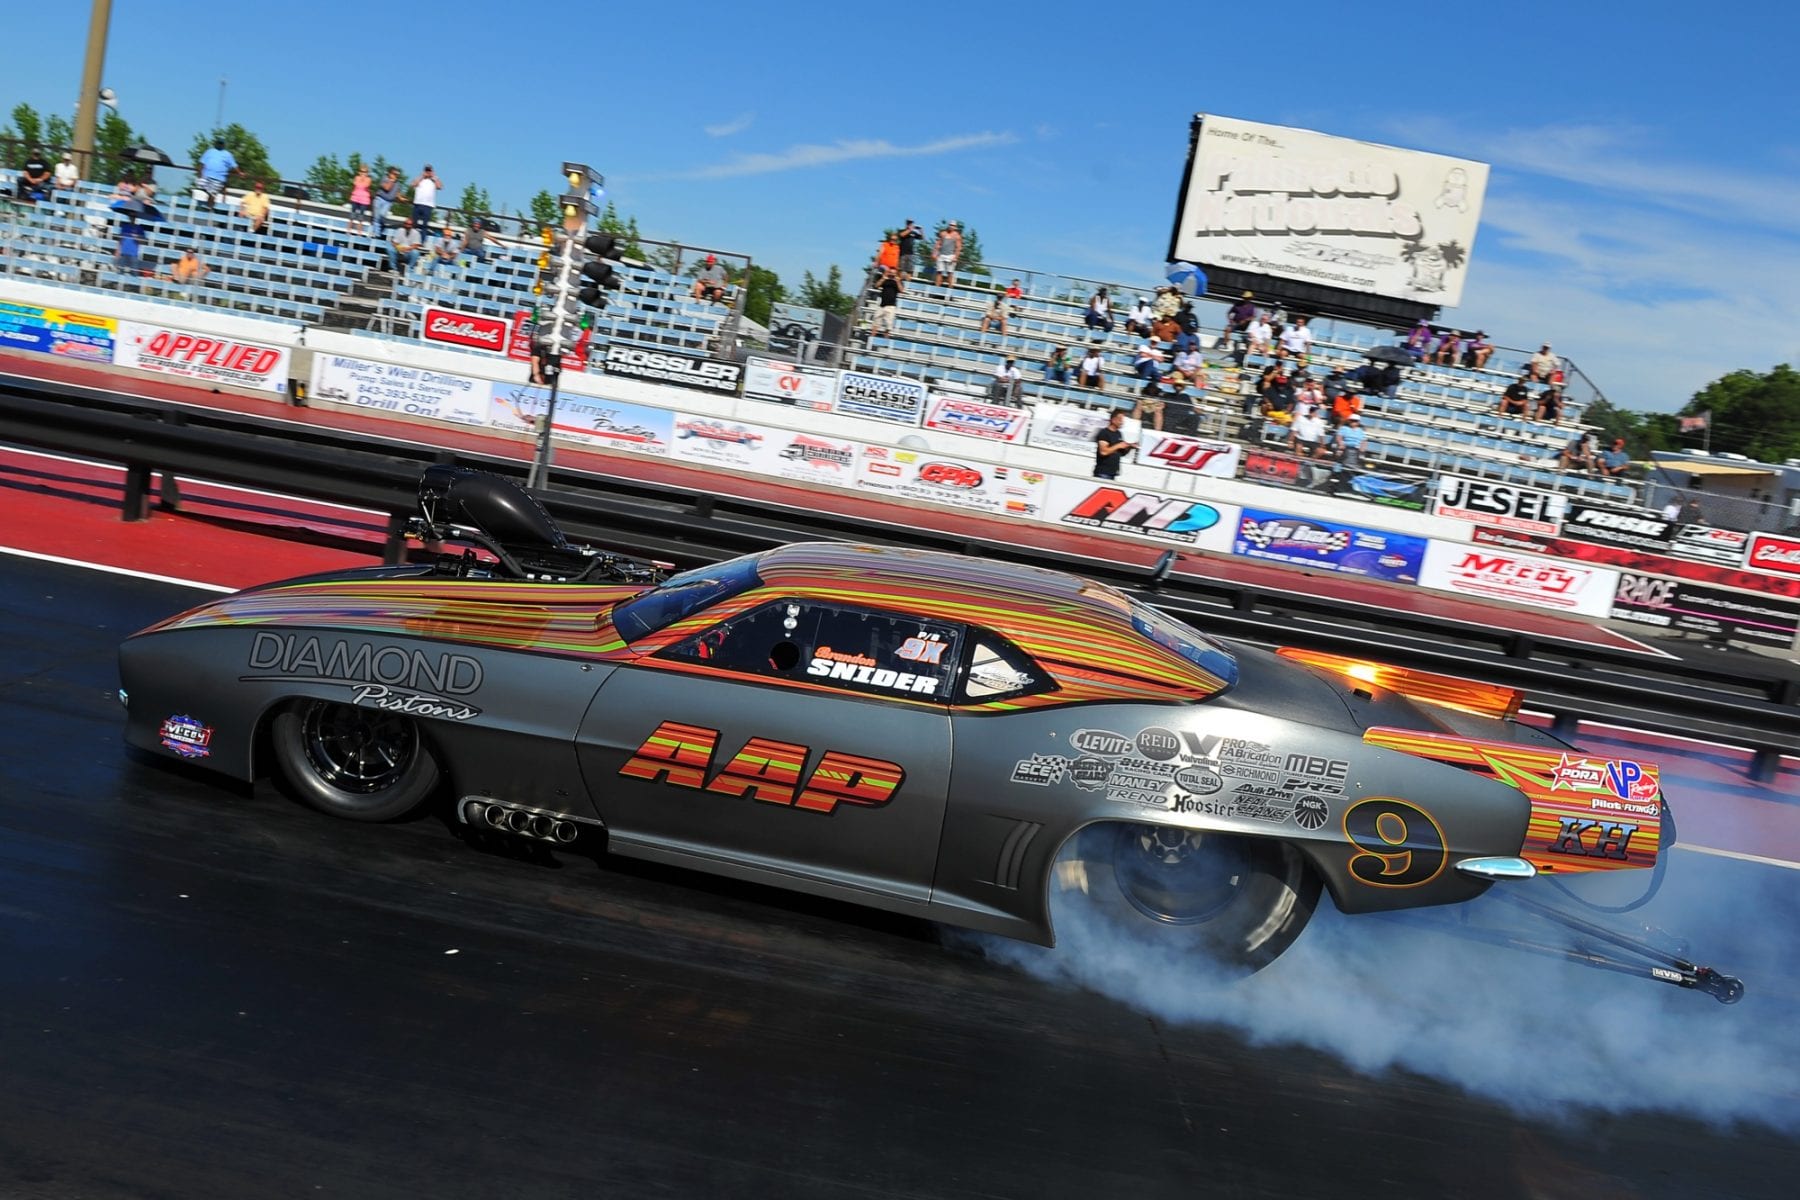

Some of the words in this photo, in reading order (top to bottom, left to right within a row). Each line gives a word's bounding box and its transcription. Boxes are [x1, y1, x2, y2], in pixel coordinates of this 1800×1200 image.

[1207, 128, 1238, 140] Home
[430, 317, 499, 343] Edelbrock
[144, 331, 281, 376] APPLIED
[607, 346, 740, 382] ROSSLER
[332, 357, 383, 374] Miller's
[388, 365, 419, 380] Well
[421, 371, 472, 391] Drilling
[349, 372, 376, 385] Pump
[380, 377, 408, 390] Sales
[606, 361, 737, 391] TRANSMISSIONS
[778, 375, 802, 392] CV
[356, 394, 398, 411] Drill
[404, 402, 440, 418] On!
[843, 395, 916, 412] ENGINEERING
[845, 385, 916, 406] CHASSIS
[944, 412, 1010, 433] RPM
[1051, 425, 1089, 438] DRIVE
[920, 464, 982, 489] CPR
[1069, 487, 1220, 533] AMD
[1443, 481, 1557, 524] JESEL
[1062, 514, 1101, 527] AUTO
[1101, 521, 1145, 534] METAL
[1147, 528, 1197, 543] DIRECT
[1576, 509, 1668, 537] PENSKE
[1620, 574, 1678, 610] RACE
[248, 631, 484, 694] DIAMOND
[815, 646, 877, 668] Brandon
[894, 637, 948, 665] 9X
[807, 658, 938, 694] SNIDER
[351, 684, 477, 720] Pistons
[1072, 730, 1132, 756] CLEVITE
[1140, 733, 1177, 750] REID
[1222, 737, 1247, 750] PRO
[1119, 757, 1180, 774] BULLET
[1179, 753, 1219, 767] Valvoline
[1218, 747, 1282, 765] FABrication
[1284, 754, 1349, 780] MBE
[618, 719, 907, 818] AAP
[1017, 762, 1053, 778] SCE
[1179, 773, 1200, 785] TOTAL
[1200, 775, 1218, 787] SEAL
[1236, 767, 1277, 783] RICHMOND
[1560, 768, 1600, 782] PDRA
[1605, 760, 1641, 800] VP
[1110, 774, 1166, 792] MANLEY
[1266, 787, 1294, 799] Drive
[1282, 778, 1345, 794] PRS
[1107, 788, 1168, 805] TREND
[1170, 794, 1235, 818] Hoosier
[1303, 800, 1322, 811] NGK
[1591, 798, 1622, 811] Pilot
[1623, 804, 1648, 815] FLYING
[1341, 796, 1448, 889] 9
[1548, 816, 1639, 860] KH
